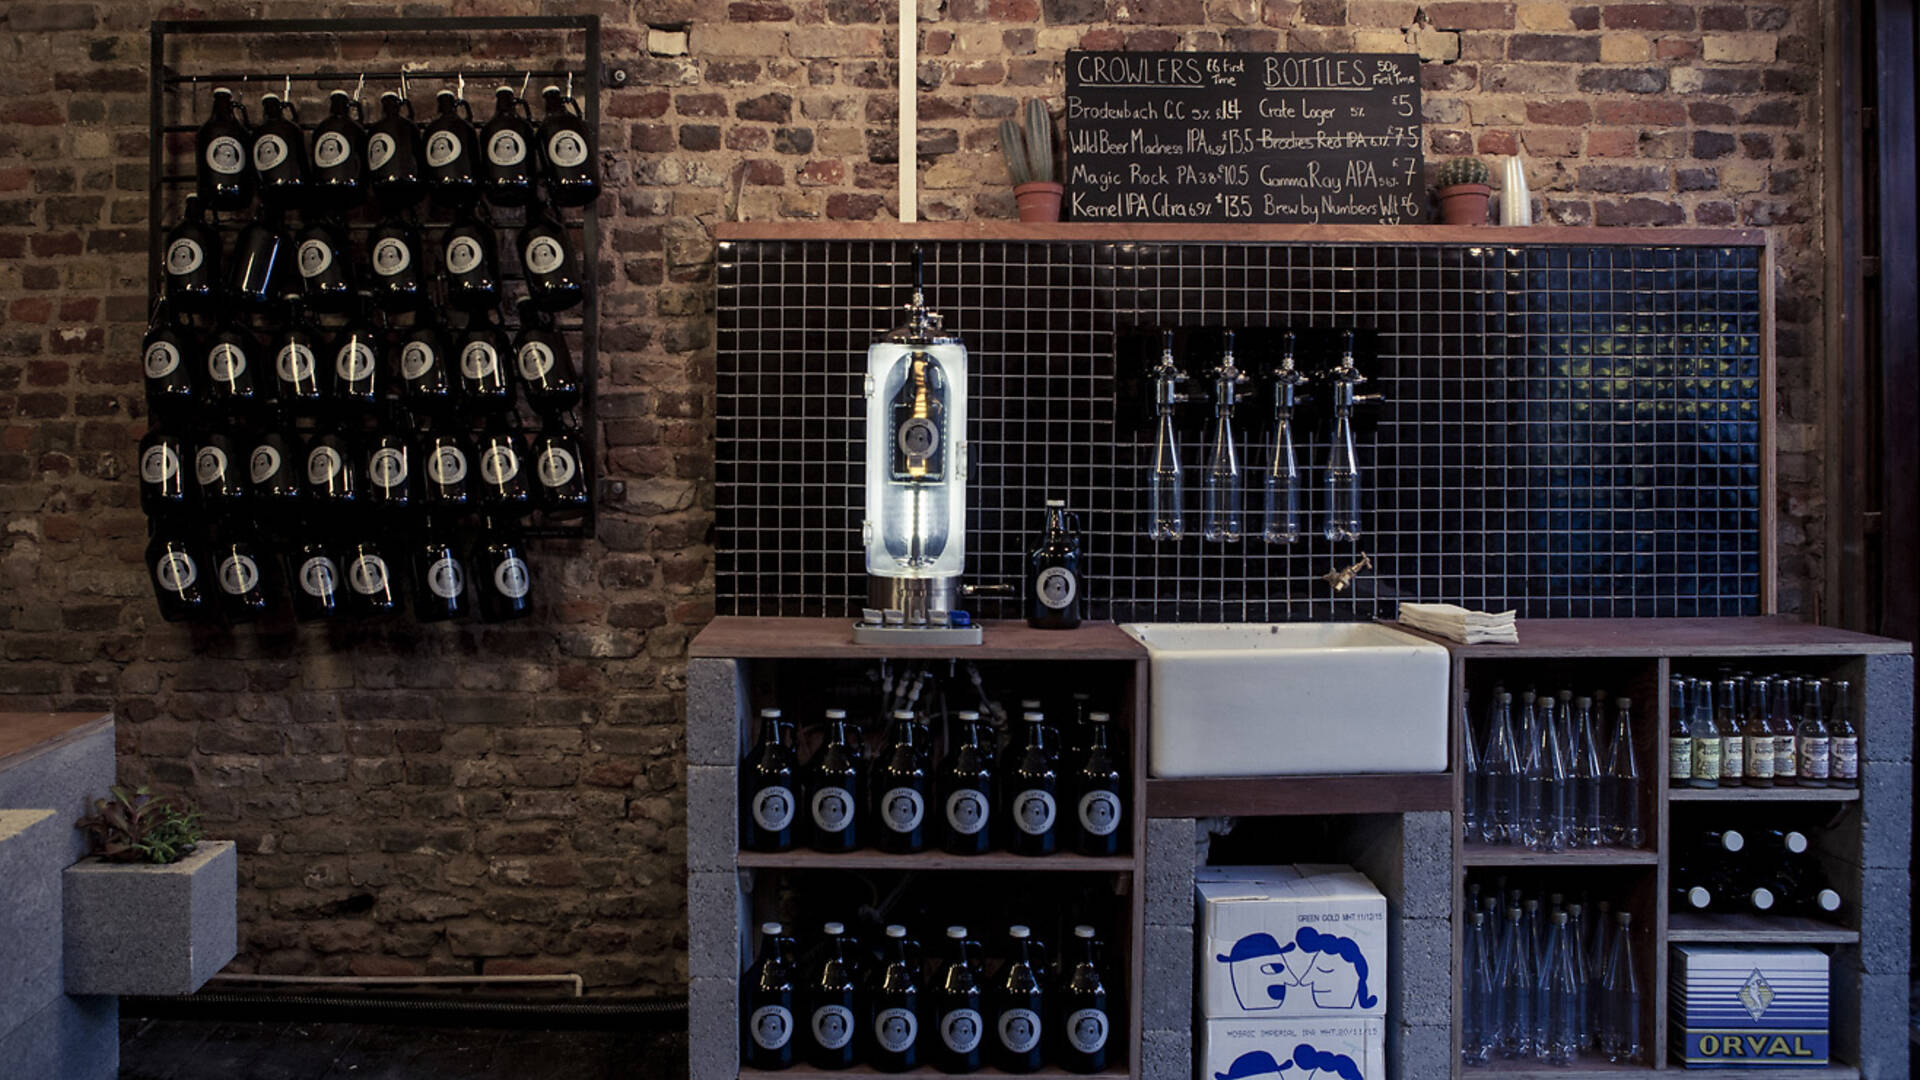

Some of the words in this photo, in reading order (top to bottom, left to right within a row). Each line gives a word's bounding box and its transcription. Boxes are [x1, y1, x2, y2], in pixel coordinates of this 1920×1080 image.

[1077, 56, 1203, 83] GROWLERS
[1211, 73, 1237, 87] Time
[1263, 56, 1366, 87] BOTTLES
[1394, 72, 1416, 85] Time
[1191, 110, 1211, 120] 5%
[1259, 98, 1296, 118] Crate
[1302, 98, 1336, 126] Lager
[1350, 107, 1365, 117] 5%
[1391, 94, 1414, 117] £5
[1131, 129, 1183, 155] Madness
[1187, 129, 1208, 154] IPA
[1262, 128, 1313, 150] Brodies
[1316, 130, 1342, 150] Red
[1346, 131, 1367, 149] IPA
[1071, 163, 1121, 191] Magic
[1129, 163, 1169, 185] Rock
[1177, 164, 1197, 185] PA
[1345, 160, 1378, 188] APA
[1072, 192, 1122, 217] Kernel
[1126, 193, 1149, 217] IPA
[1152, 192, 1186, 217] Citra
[1263, 193, 1298, 215] Brew
[1300, 194, 1319, 224] by
[1321, 194, 1377, 215] Numbers
[1402, 192, 1419, 217] £6
[1297, 914, 1320, 922] GREEN
[1322, 913, 1340, 922] GOLD
[1699, 1035, 1812, 1056] ORVAL
